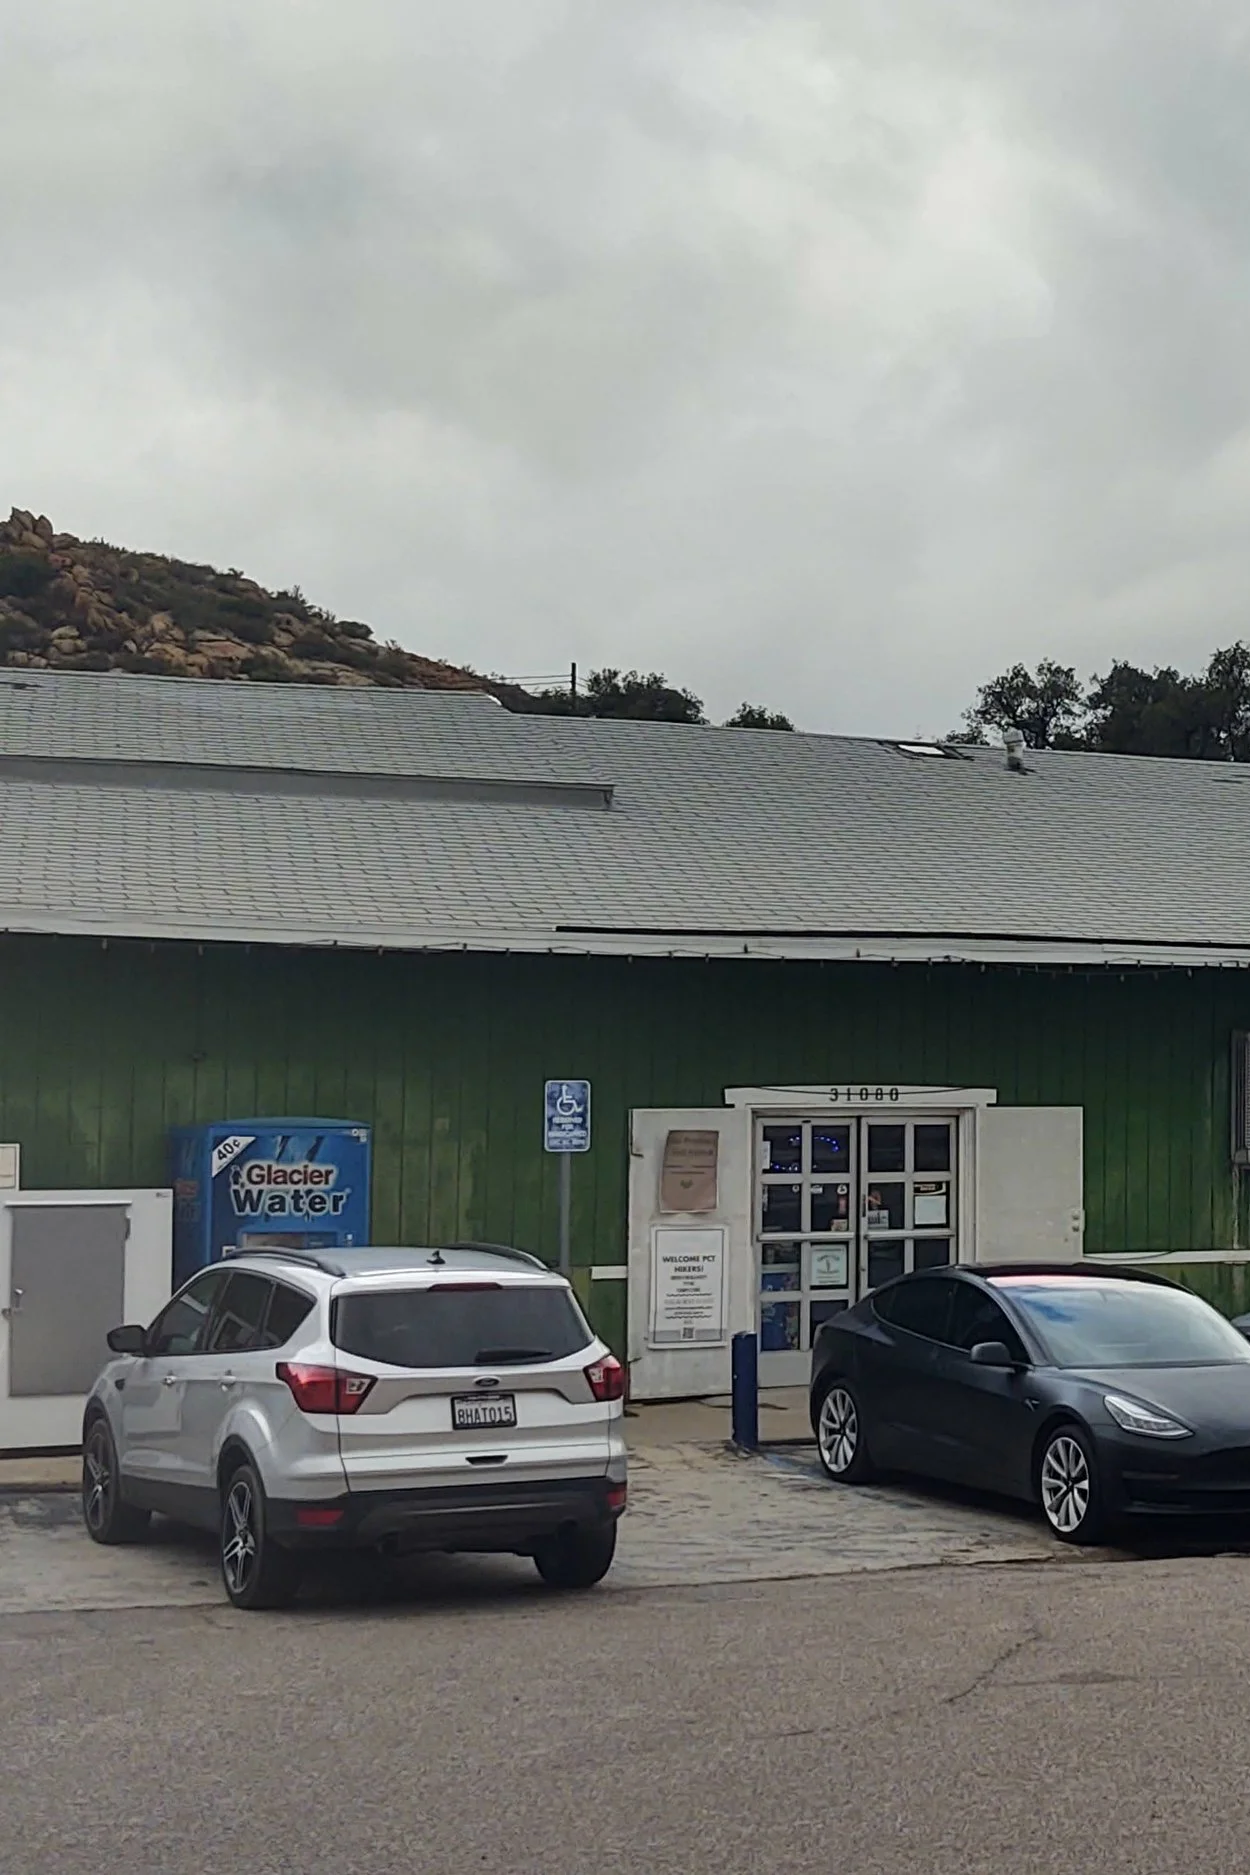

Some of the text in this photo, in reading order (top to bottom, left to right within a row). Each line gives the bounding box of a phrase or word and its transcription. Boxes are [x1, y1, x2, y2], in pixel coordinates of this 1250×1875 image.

[828, 1087, 900, 1102] 31080
[246, 1163, 334, 1186] Glacier
[232, 1188, 346, 1213] Water
[662, 1254, 716, 1263] WELCOME PCT
